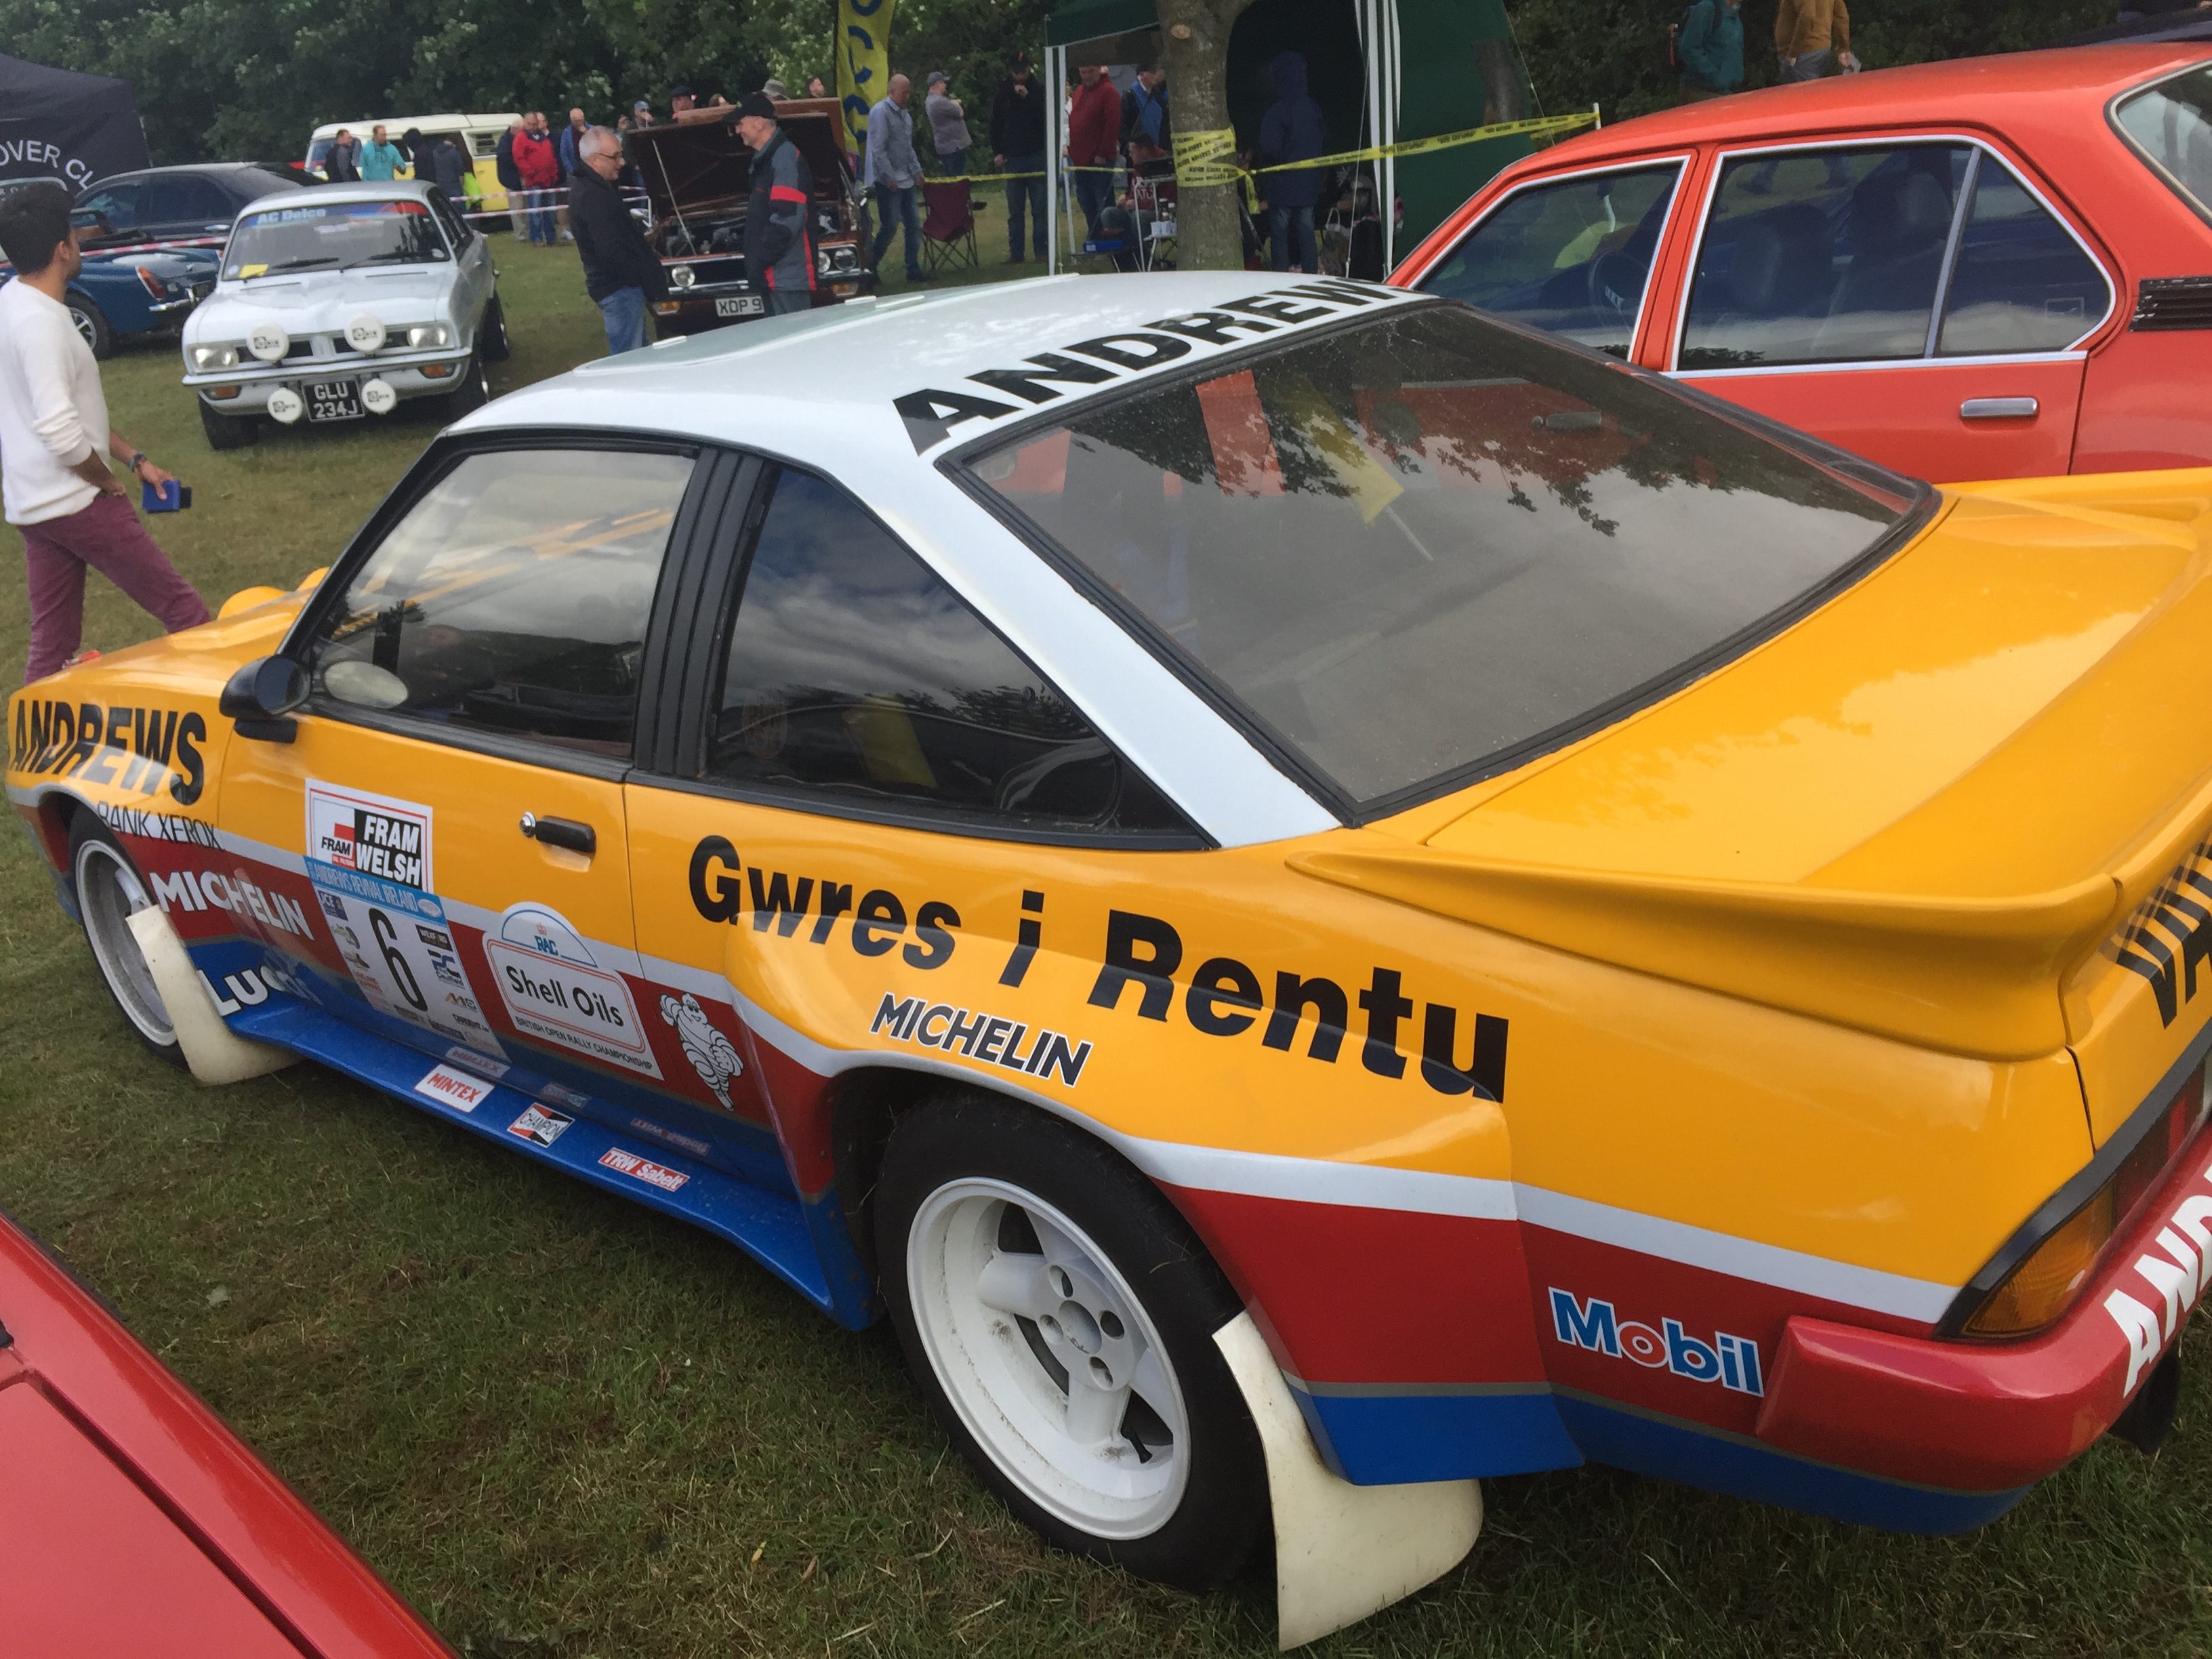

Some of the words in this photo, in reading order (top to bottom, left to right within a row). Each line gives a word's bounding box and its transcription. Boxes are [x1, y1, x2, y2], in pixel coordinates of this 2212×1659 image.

[313, 381, 349, 401] GLU
[892, 276, 1430, 457] ANDREW
[313, 398, 359, 419] 234J
[9, 699, 207, 806] ANDREWS
[157, 812, 224, 851] XEROX
[322, 836, 351, 856] FRAM
[363, 814, 420, 854] FRAM
[356, 842, 422, 886] WELSH
[148, 870, 315, 941] MICHELIN
[368, 907, 428, 1012] 6
[534, 935, 559, 956] RAC
[2116, 840, 2212, 1030] VA
[506, 965, 569, 1009] Shell
[572, 986, 625, 1027] Oils
[689, 834, 962, 970] Gwres
[998, 890, 1044, 988] i
[1086, 907, 1510, 1103] Rentu
[515, 1015, 544, 1033] BRITISH
[543, 1026, 568, 1041] OPEN
[567, 1033, 592, 1050] RALLY
[593, 1042, 653, 1070] CHAMPIONSHIP
[870, 991, 1094, 1087] MICHELIN
[427, 1072, 482, 1103] MINTEX
[519, 1113, 566, 1139] CHAMPION
[604, 1151, 641, 1172] TRW
[636, 1164, 686, 1190] Sabelt
[2104, 1164, 2212, 1399] AND
[1547, 1286, 1765, 1398] Mobil
